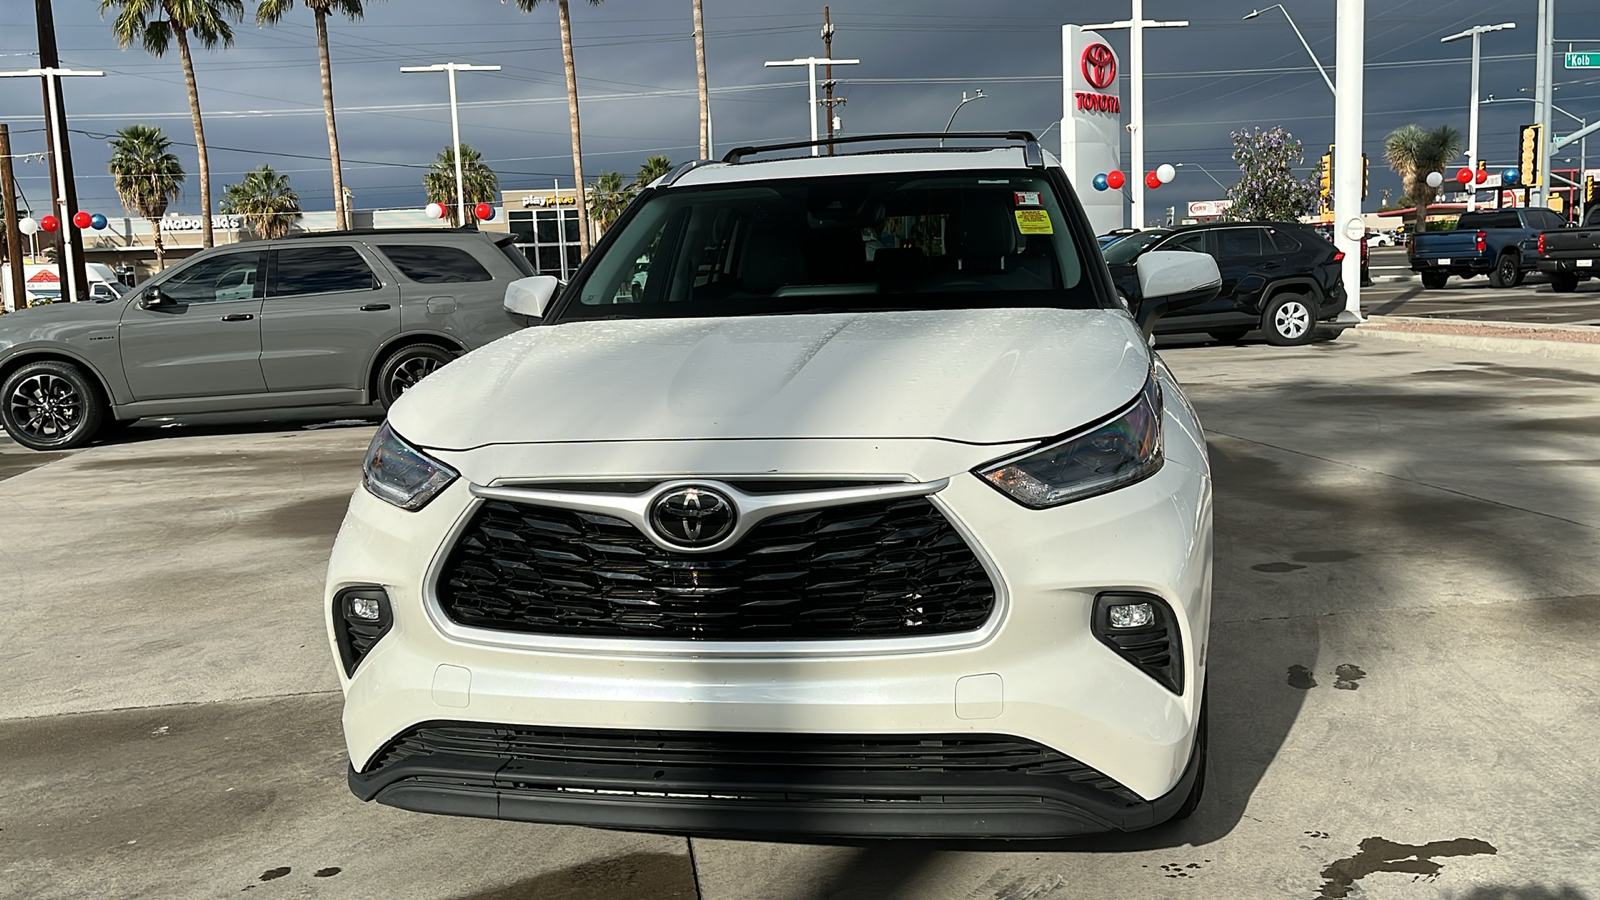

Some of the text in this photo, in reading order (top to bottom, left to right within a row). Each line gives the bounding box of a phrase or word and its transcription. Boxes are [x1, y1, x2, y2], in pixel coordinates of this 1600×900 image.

[1572, 54, 1590, 66] Kolb
[1074, 92, 1120, 113] TOYOTA
[159, 217, 240, 230] McDoald's
